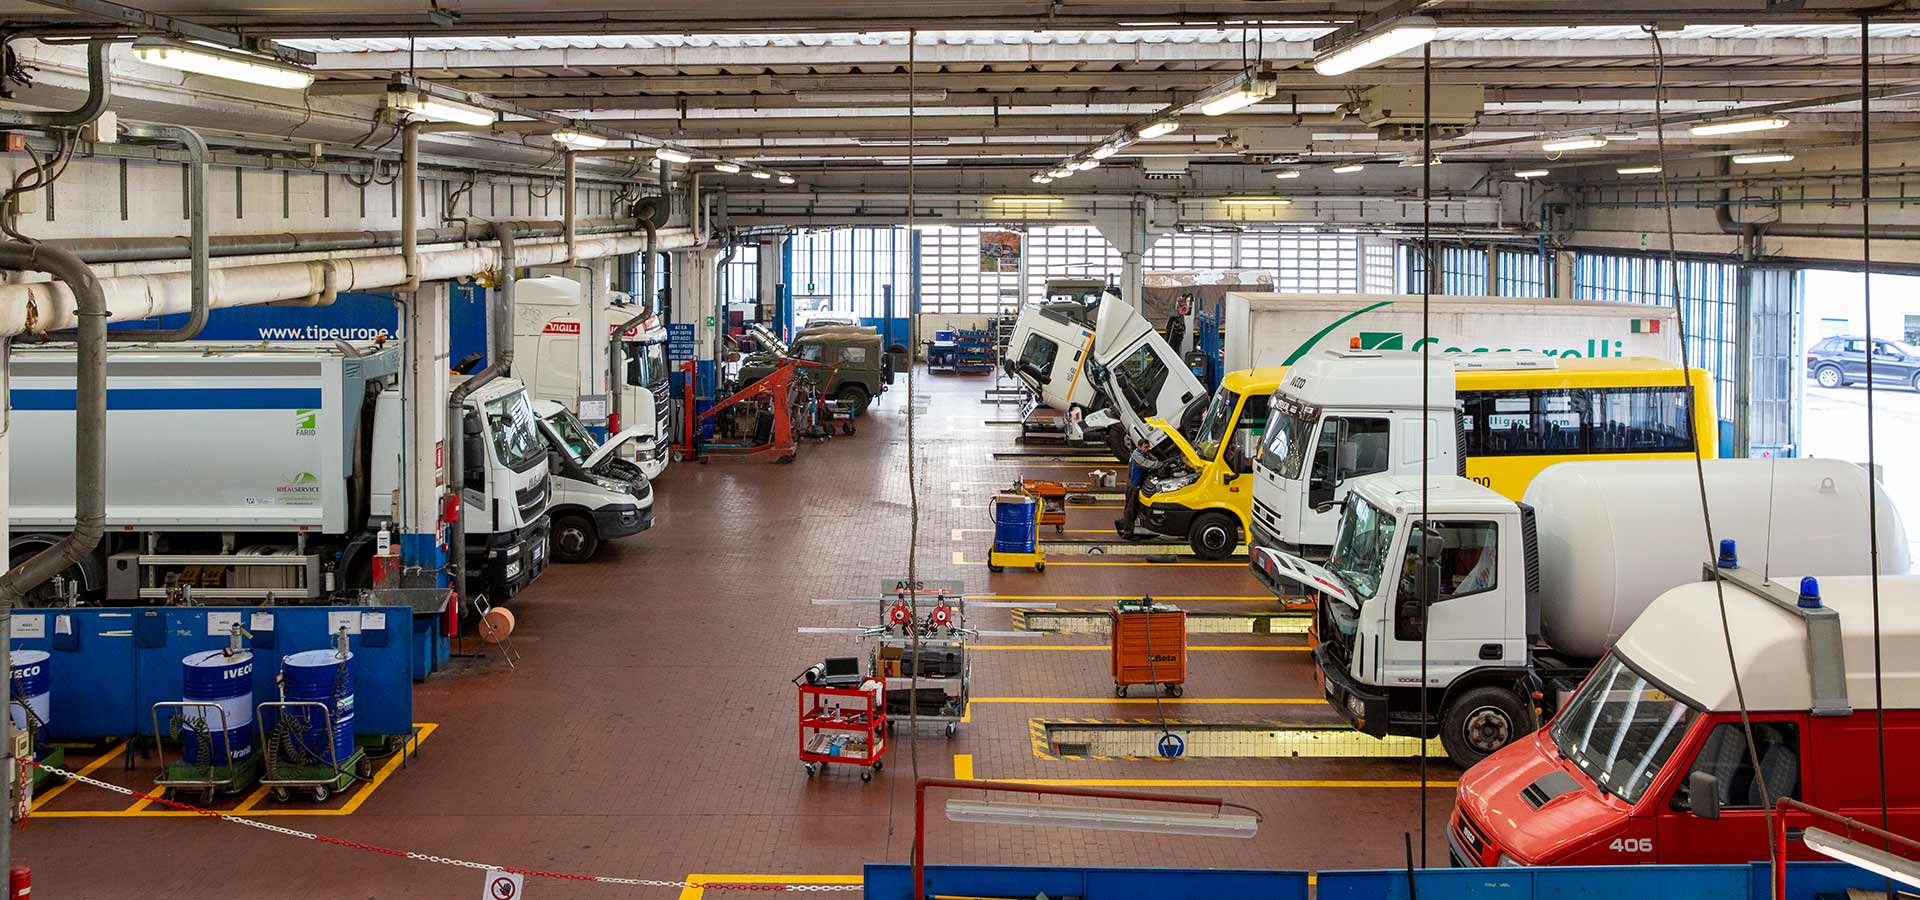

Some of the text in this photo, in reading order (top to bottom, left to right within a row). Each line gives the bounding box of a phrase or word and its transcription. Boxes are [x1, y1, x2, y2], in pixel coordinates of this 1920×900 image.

[550, 323, 577, 332] VIGILI
[224, 663, 253, 680] IVECO
[1609, 838, 1653, 852] 406
